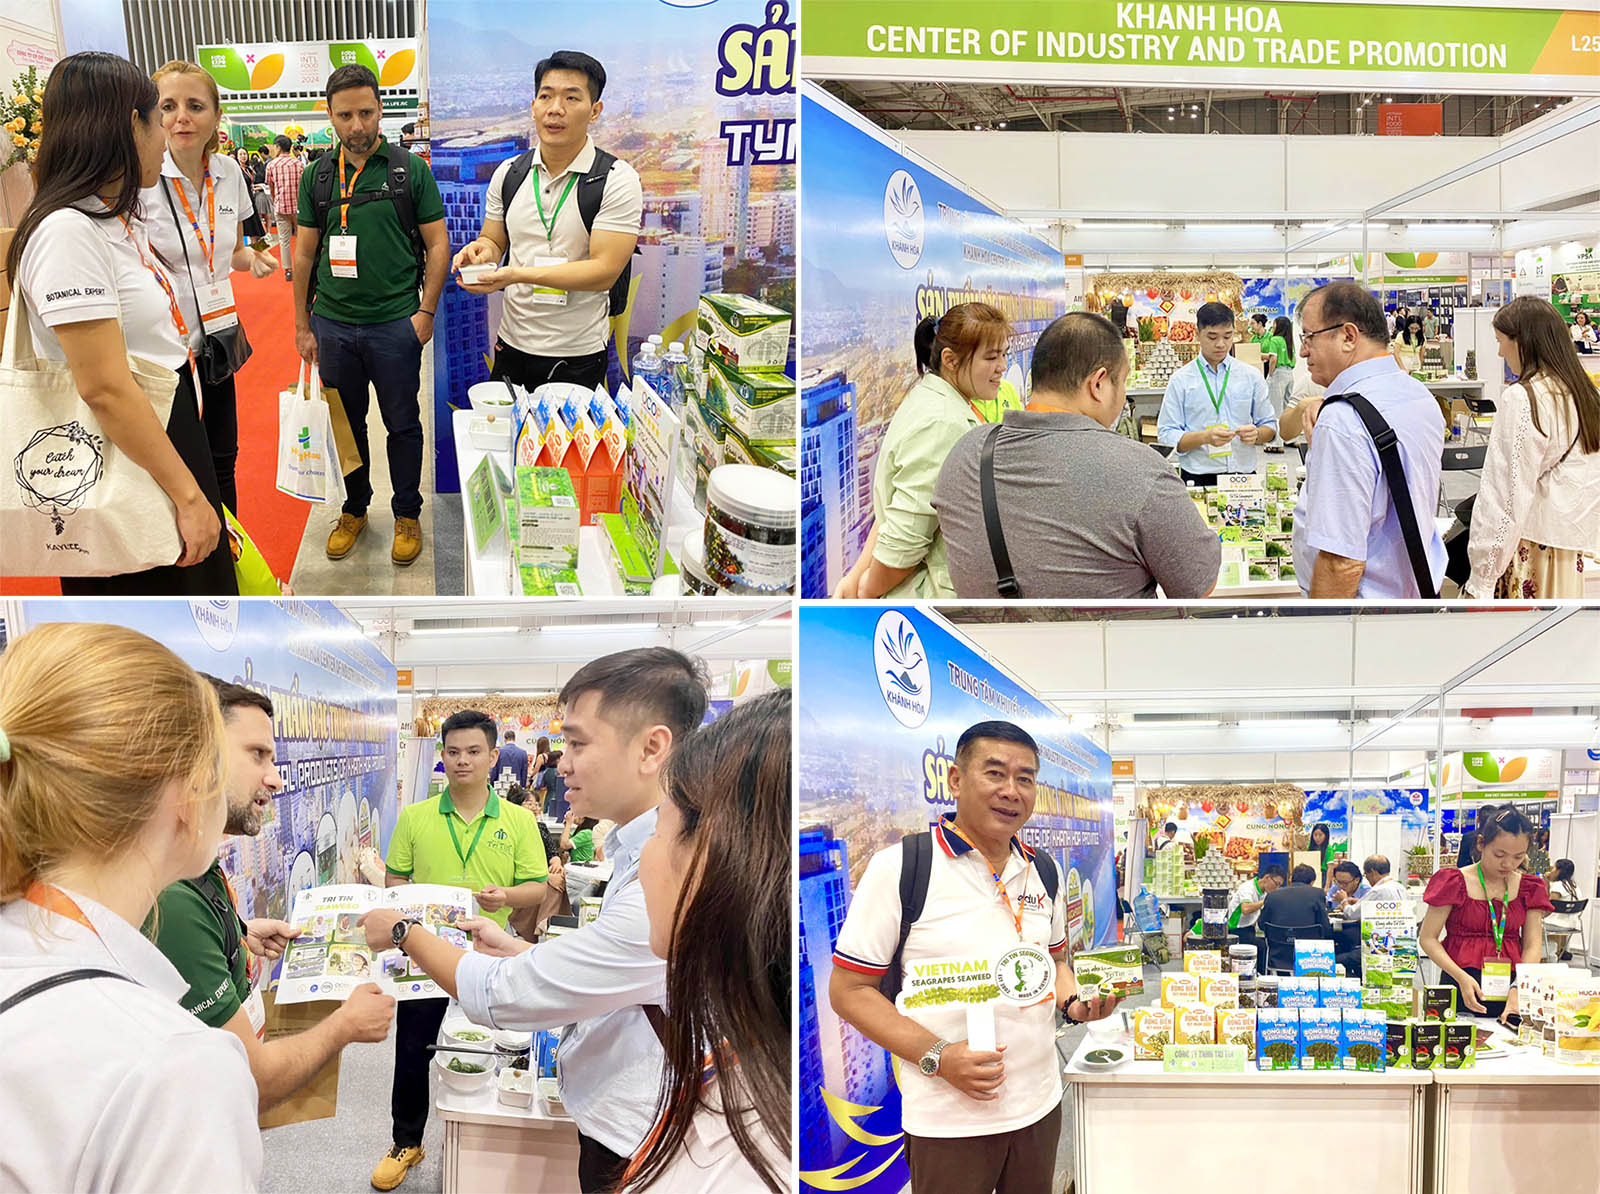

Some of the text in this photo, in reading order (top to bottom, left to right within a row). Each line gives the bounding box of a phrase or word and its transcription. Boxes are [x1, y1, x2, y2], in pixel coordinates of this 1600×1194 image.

[1117, 2, 1283, 34] KHANH HOA
[867, 25, 1507, 69] CENTER OF INDUSTRY AND TRADE PROMOTION
[45, 288, 82, 303] BOTANICAL
[45, 447, 75, 464] Catch
[29, 467, 54, 480] your
[947, 661, 979, 698] TRUNG
[979, 678, 995, 705] TÂM
[886, 689, 925, 716] KHÁNH HÒA
[297, 758, 339, 792] PRODUCTS
[314, 903, 360, 911] SEAWEED
[1375, 902, 1402, 910] OCOP
[1018, 950, 1044, 962] SEAWEED
[913, 959, 989, 978] VIETNAM
[911, 972, 992, 987] SEAGRAPES SEAWEED
